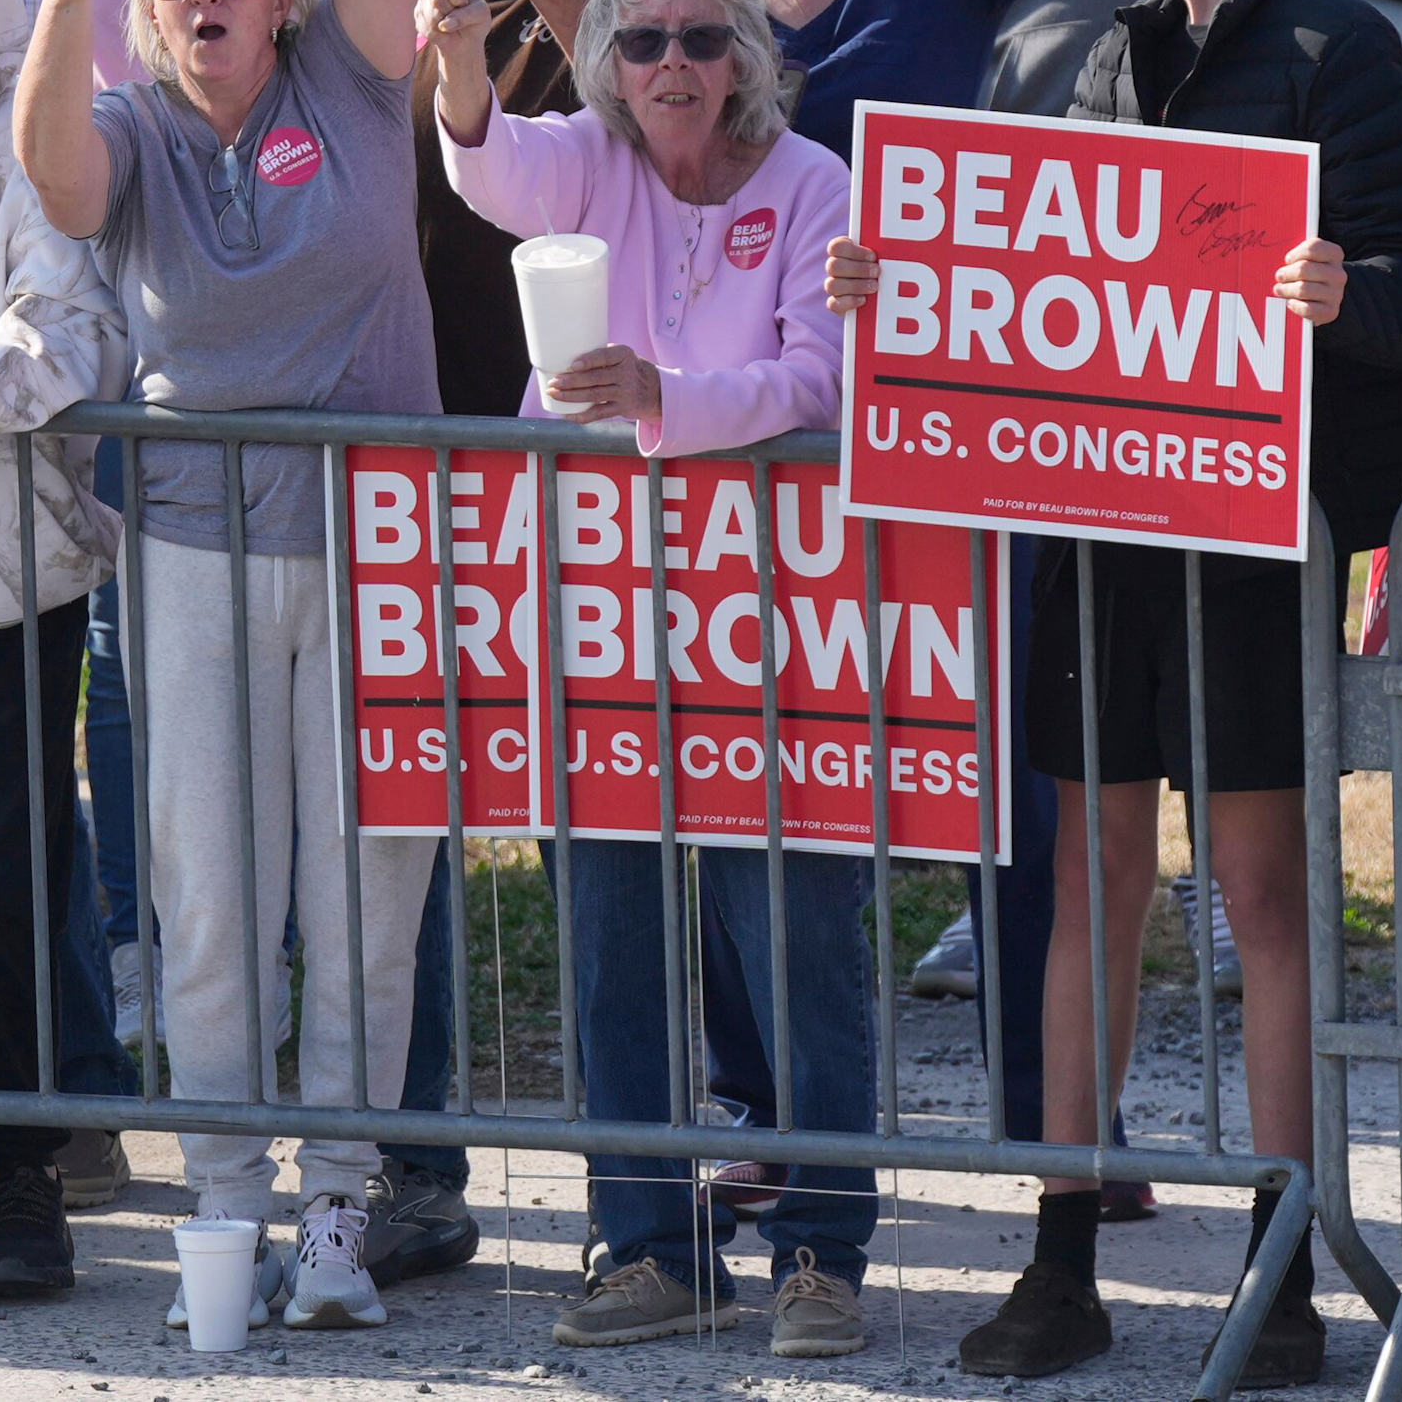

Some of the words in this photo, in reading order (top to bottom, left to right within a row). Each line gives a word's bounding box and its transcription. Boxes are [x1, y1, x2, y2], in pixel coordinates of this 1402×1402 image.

[258, 139, 292, 166] BEAU
[263, 141, 313, 174] BROWN
[879, 144, 1162, 263] BEAU
[731, 228, 773, 246] BROWN
[733, 222, 766, 236] BEAU
[874, 258, 1287, 393] BROWN
[867, 405, 969, 458] U.S.
[988, 417, 1287, 491] CONGRESS
[556, 471, 846, 577] BEAU
[983, 498, 1004, 508] PAID
[1006, 499, 1024, 510] FOR
[1026, 502, 1038, 511] BY
[1039, 503, 1063, 514] BEAU
[1065, 505, 1098, 517] BROWN
[1100, 509, 1119, 519] FOR
[1120, 511, 1169, 525] CONGRESS
[357, 583, 528, 678] BR
[562, 585, 976, 701] BROWN
[360, 729, 468, 773] U.S.
[681, 736, 979, 797] CONGRESS
[489, 808, 511, 818] PAID
[679, 814, 701, 824] PAID
[703, 815, 723, 825] FOR
[725, 816, 737, 826] BY
[739, 816, 765, 827] BEAU
[803, 820, 821, 830] FOR
[823, 821, 871, 834] CONGRESS
